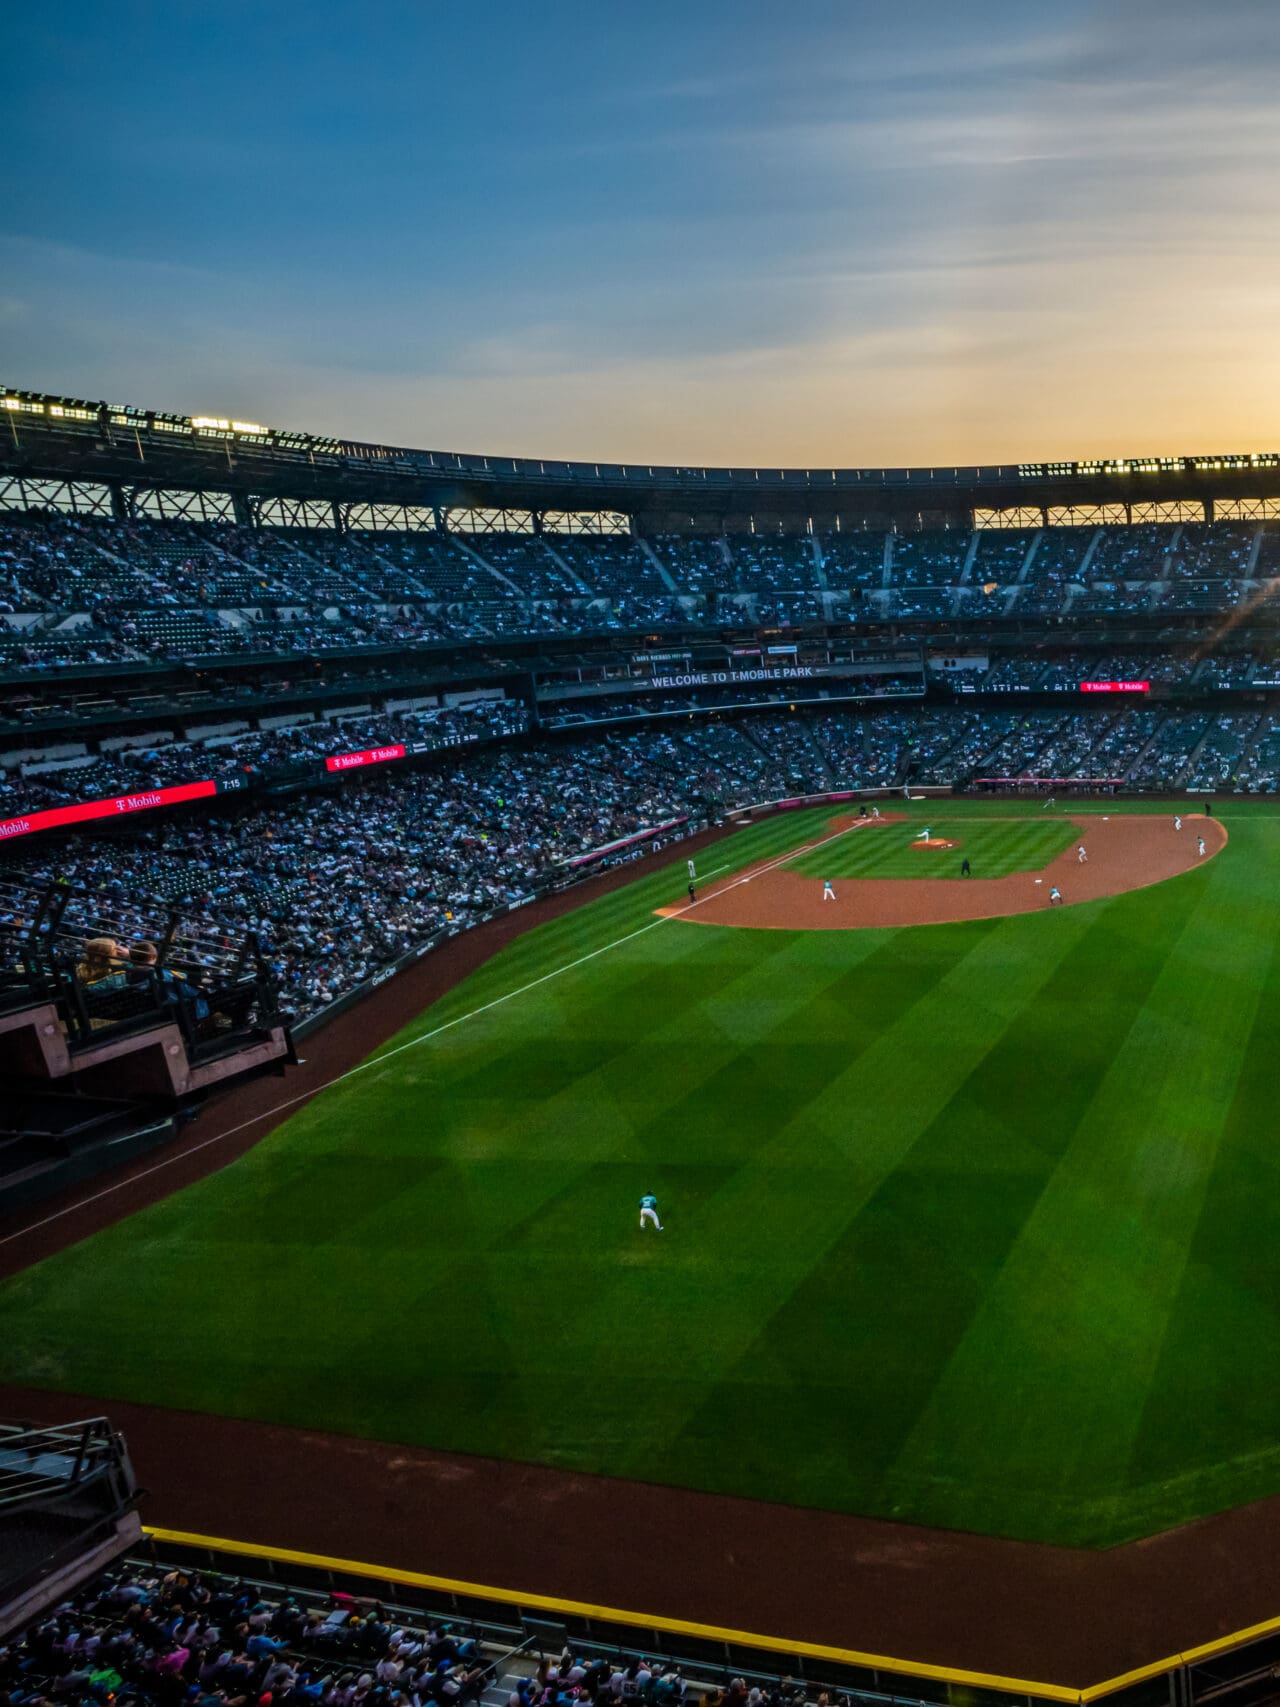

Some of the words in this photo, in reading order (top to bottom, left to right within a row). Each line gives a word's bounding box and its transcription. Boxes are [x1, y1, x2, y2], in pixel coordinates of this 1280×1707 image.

[652, 673, 708, 688] WELCOME
[711, 672, 727, 682] TO
[783, 666, 812, 678] PARK
[378, 748, 398, 759] Mobile
[341, 755, 363, 766] Mobile
[222, 778, 241, 790] 7:15
[127, 795, 161, 809] Mobile
